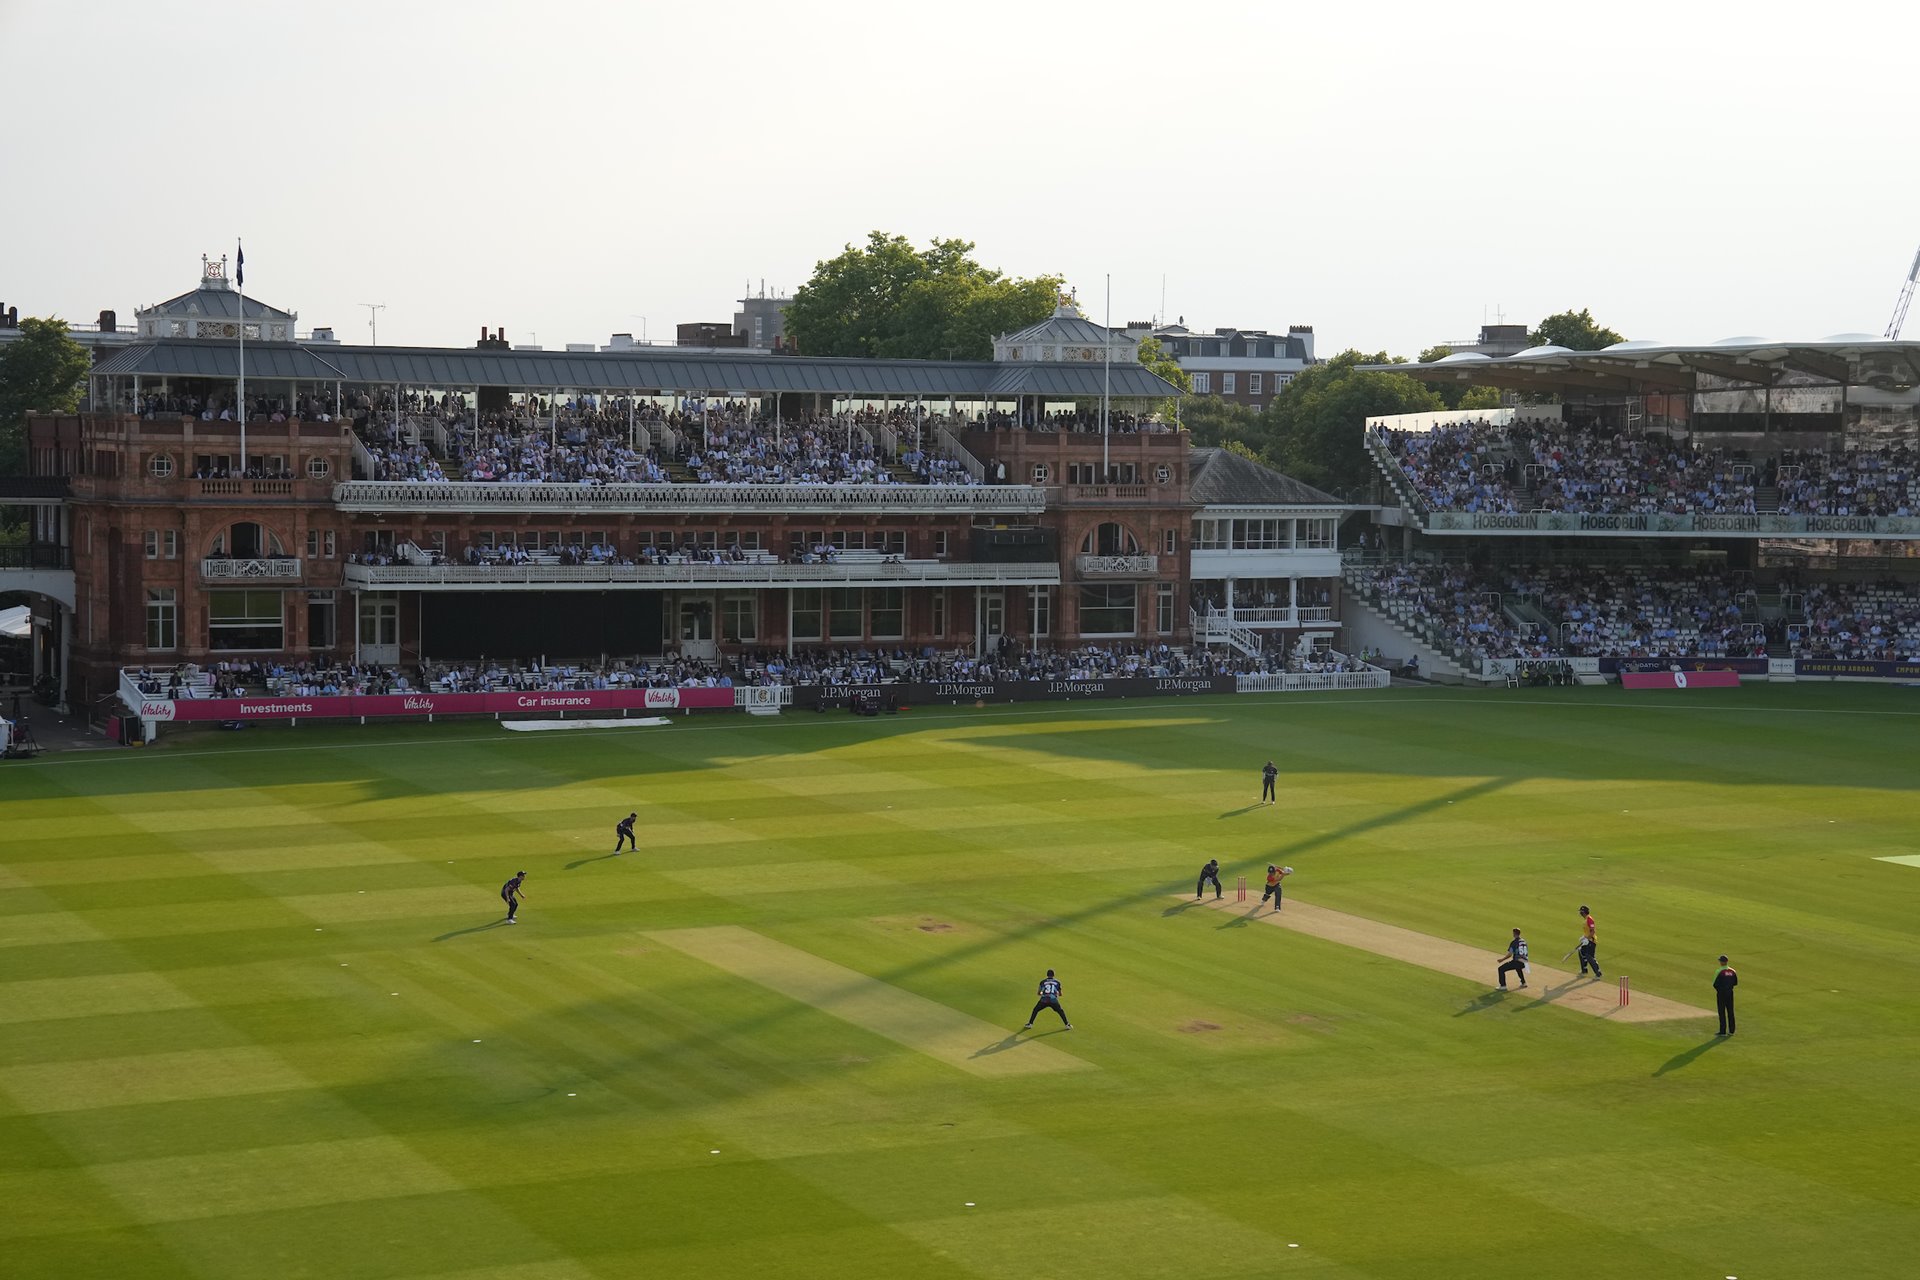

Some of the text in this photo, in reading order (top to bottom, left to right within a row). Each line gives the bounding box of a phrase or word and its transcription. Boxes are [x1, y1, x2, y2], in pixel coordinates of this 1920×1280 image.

[1473, 514, 1538, 530] HOBGOBLIN
[1580, 515, 1648, 530] HOBGOBLIN
[1692, 516, 1760, 532] HOBGOBLIN
[1806, 517, 1876, 533] HOBGOBLIN
[936, 684, 994, 697] J.P.Morgan
[1048, 682, 1104, 695] J.P.Morgan
[1156, 679, 1211, 692] J.P.Morgan
[404, 696, 434, 712] Vitality
[518, 696, 591, 707] Car insurance
[648, 690, 676, 705] Vitality
[141, 702, 171, 718] Vitality
[240, 703, 312, 714] Investments
[1045, 984, 1055, 993] 31
